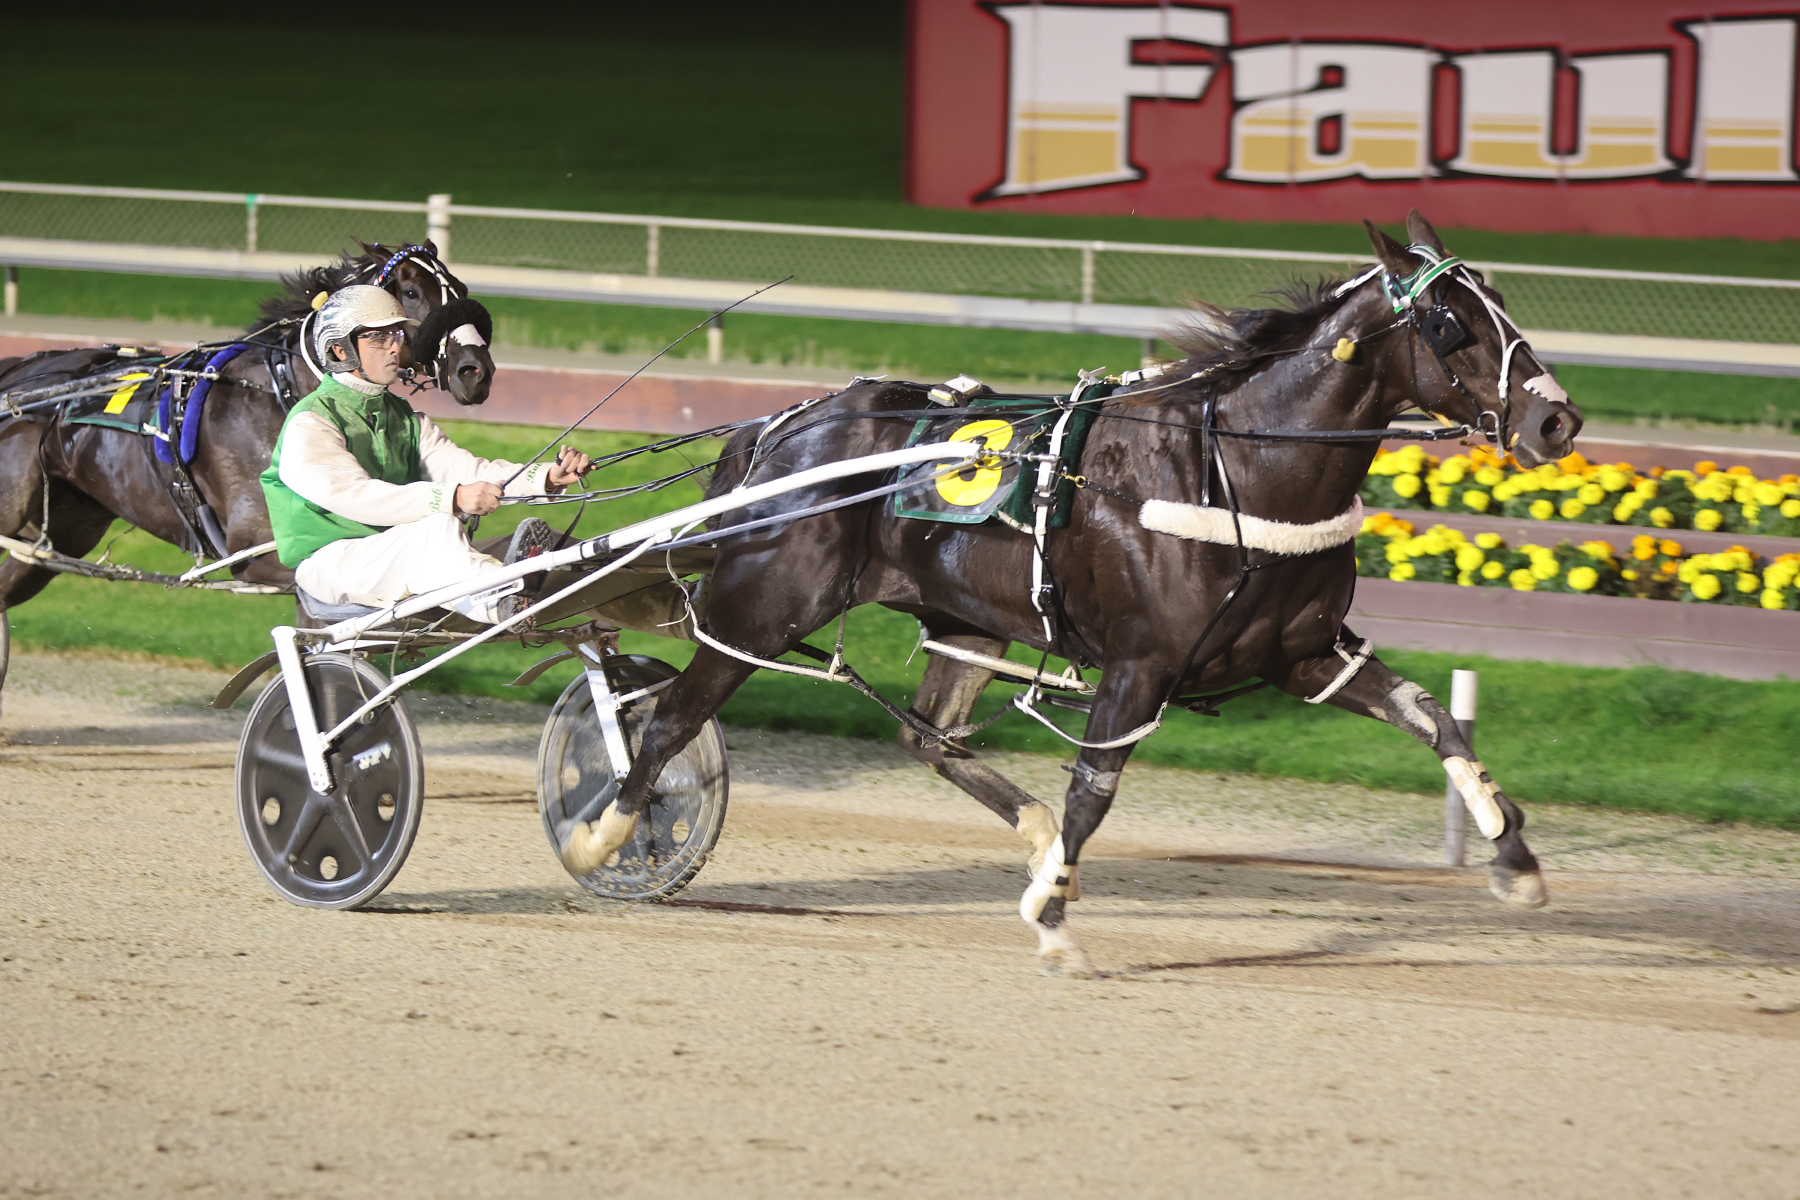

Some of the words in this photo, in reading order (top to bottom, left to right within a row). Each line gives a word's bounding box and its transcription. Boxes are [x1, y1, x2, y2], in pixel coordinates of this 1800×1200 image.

[975, 0, 1800, 201] Faul
[429, 488, 442, 512] Bob
[935, 419, 1014, 507] 3
